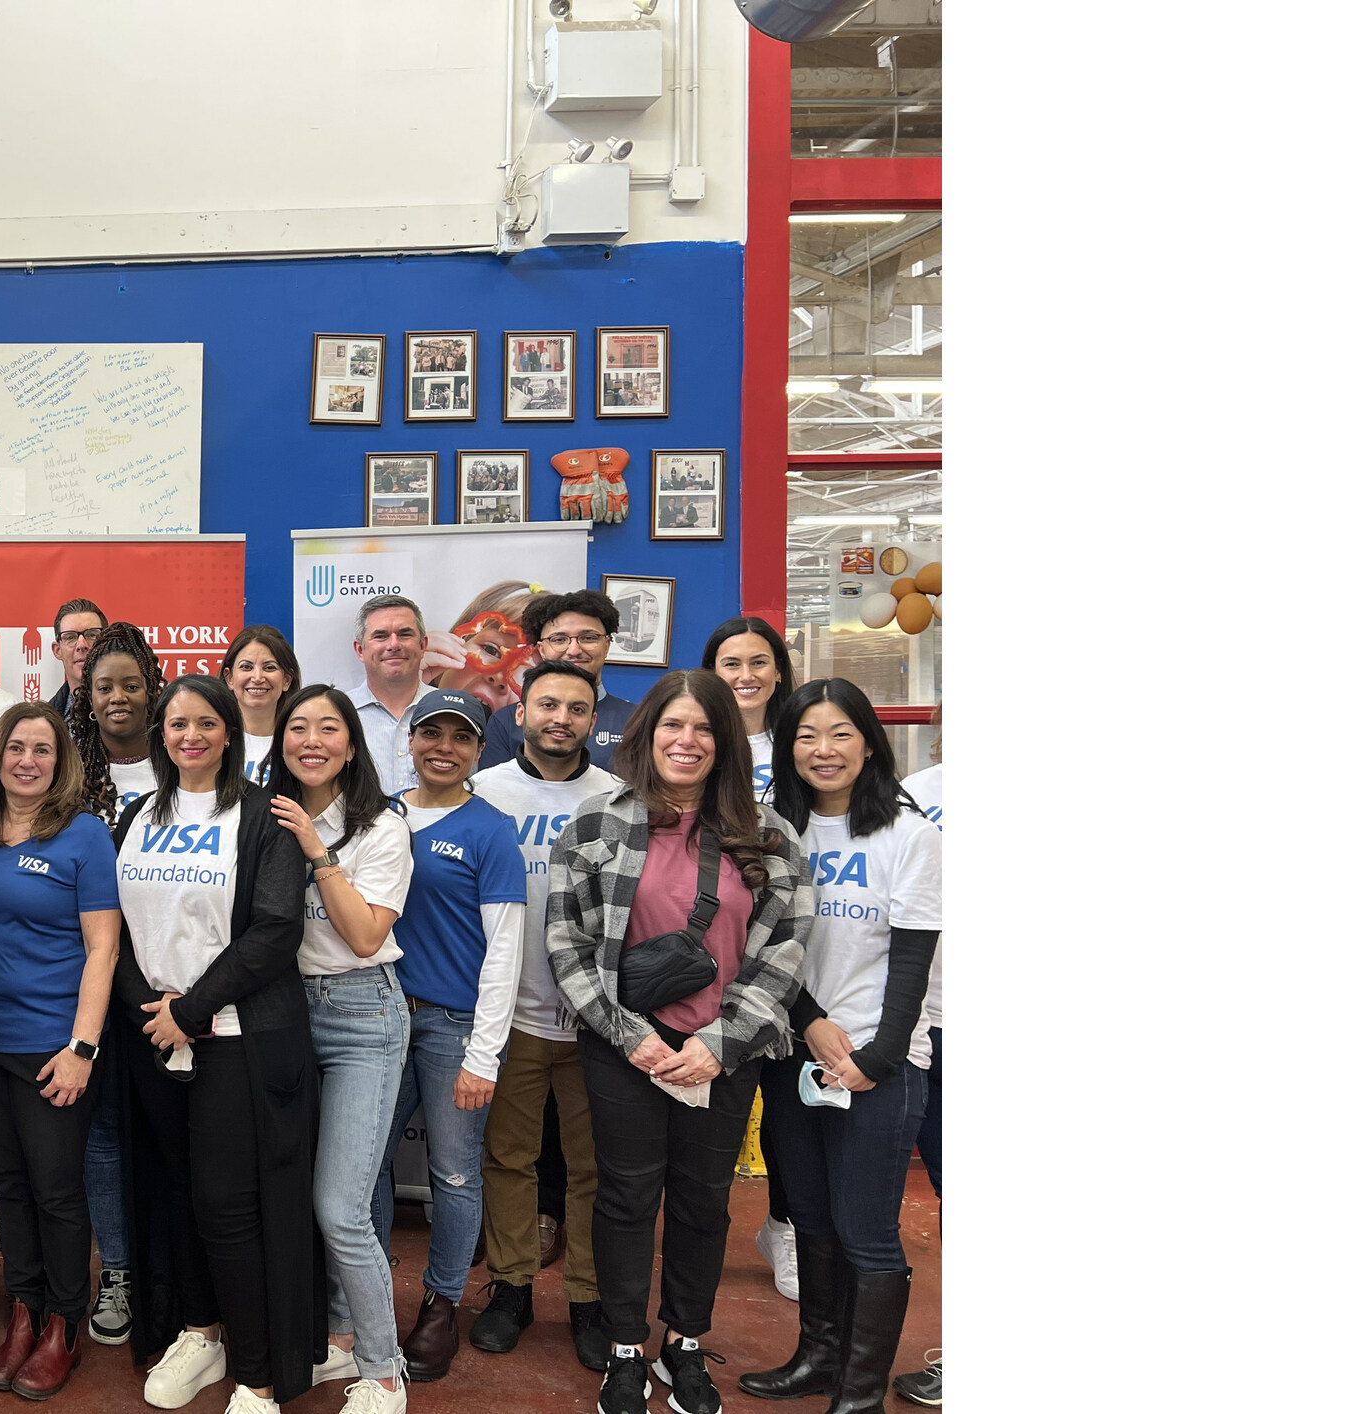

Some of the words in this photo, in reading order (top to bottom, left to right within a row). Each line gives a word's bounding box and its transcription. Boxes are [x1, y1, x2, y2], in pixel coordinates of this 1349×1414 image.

[4, 370, 18, 383] ever
[18, 357, 43, 374] become
[43, 347, 57, 361] poor
[10, 358, 24, 369] one
[22, 350, 38, 361] has
[24, 385, 36, 394] feel
[35, 370, 59, 387] blessed
[73, 351, 86, 362] able
[109, 390, 119, 398] are
[119, 381, 133, 393] each
[134, 377, 142, 387] of
[153, 365, 175, 380] angels
[7, 385, 20, 395] by
[25, 389, 47, 404] support
[46, 381, 58, 389] this
[159, 380, 171, 388] and
[96, 470, 116, 484] Every
[136, 453, 153, 465] needs
[108, 477, 128, 491] proper
[131, 464, 158, 480] nutrition
[165, 523, 184, 534] people
[184, 524, 192, 532] do
[340, 575, 374, 584] FEED
[340, 585, 401, 596] ONTARIO
[166, 626, 230, 644] YORK
[443, 696, 464, 704] VISA
[141, 824, 220, 855] VISA
[431, 840, 463, 860] VISA
[18, 855, 50, 874] VISA
[809, 851, 868, 888] ISA
[121, 864, 226, 886] Foundation
